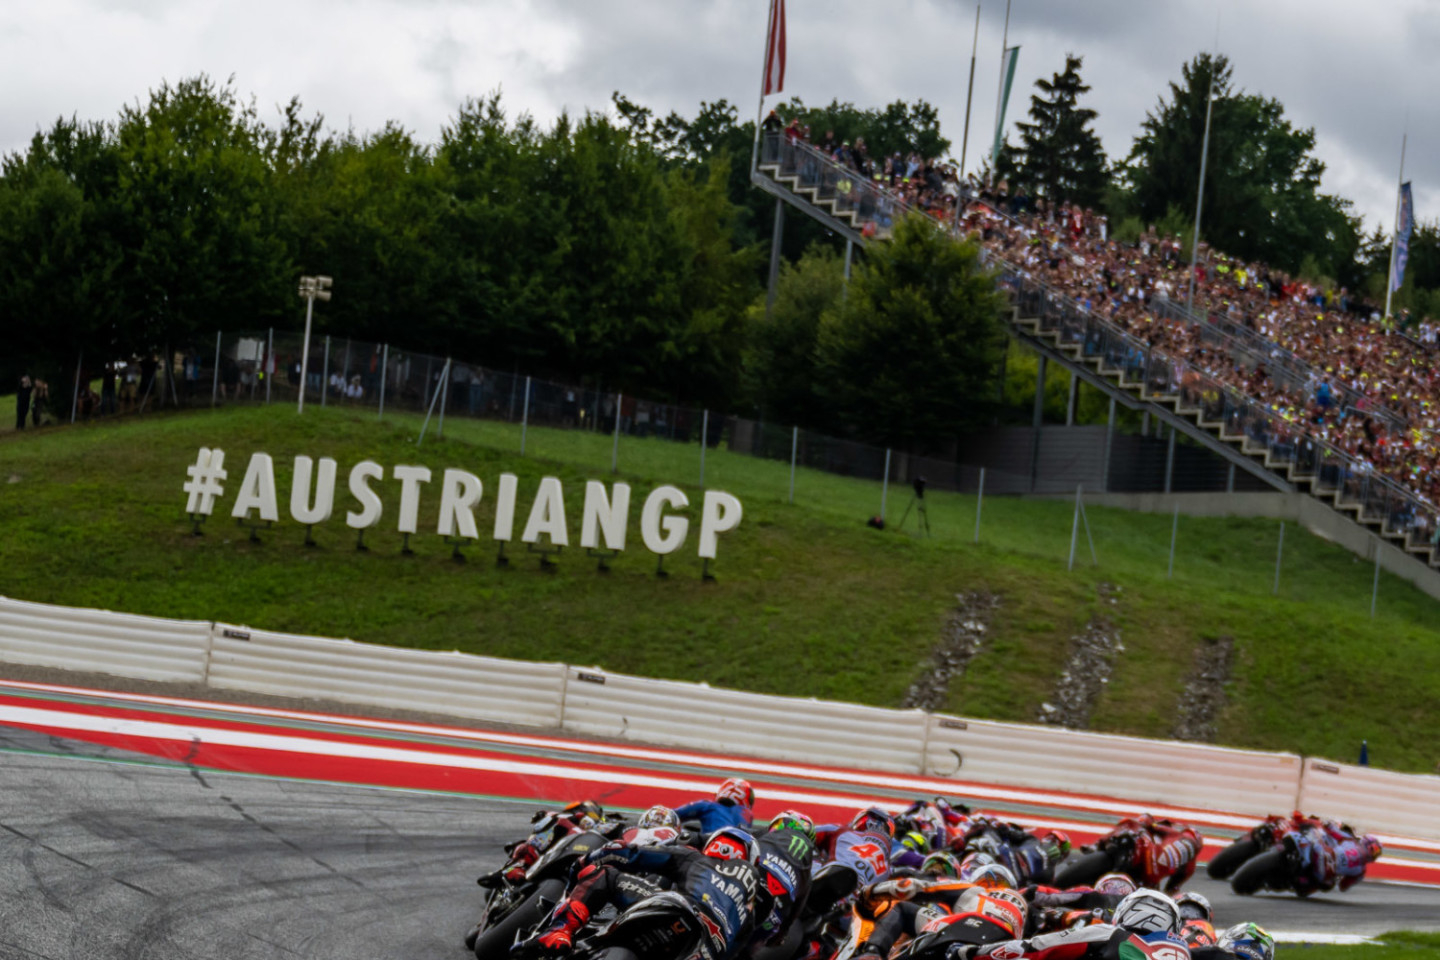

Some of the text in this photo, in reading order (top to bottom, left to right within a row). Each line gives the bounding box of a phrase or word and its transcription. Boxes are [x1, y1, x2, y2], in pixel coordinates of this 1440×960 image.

[183, 447, 743, 559] #AUSTRIANGP
[849, 843, 886, 876] 49
[715, 864, 757, 901] with
